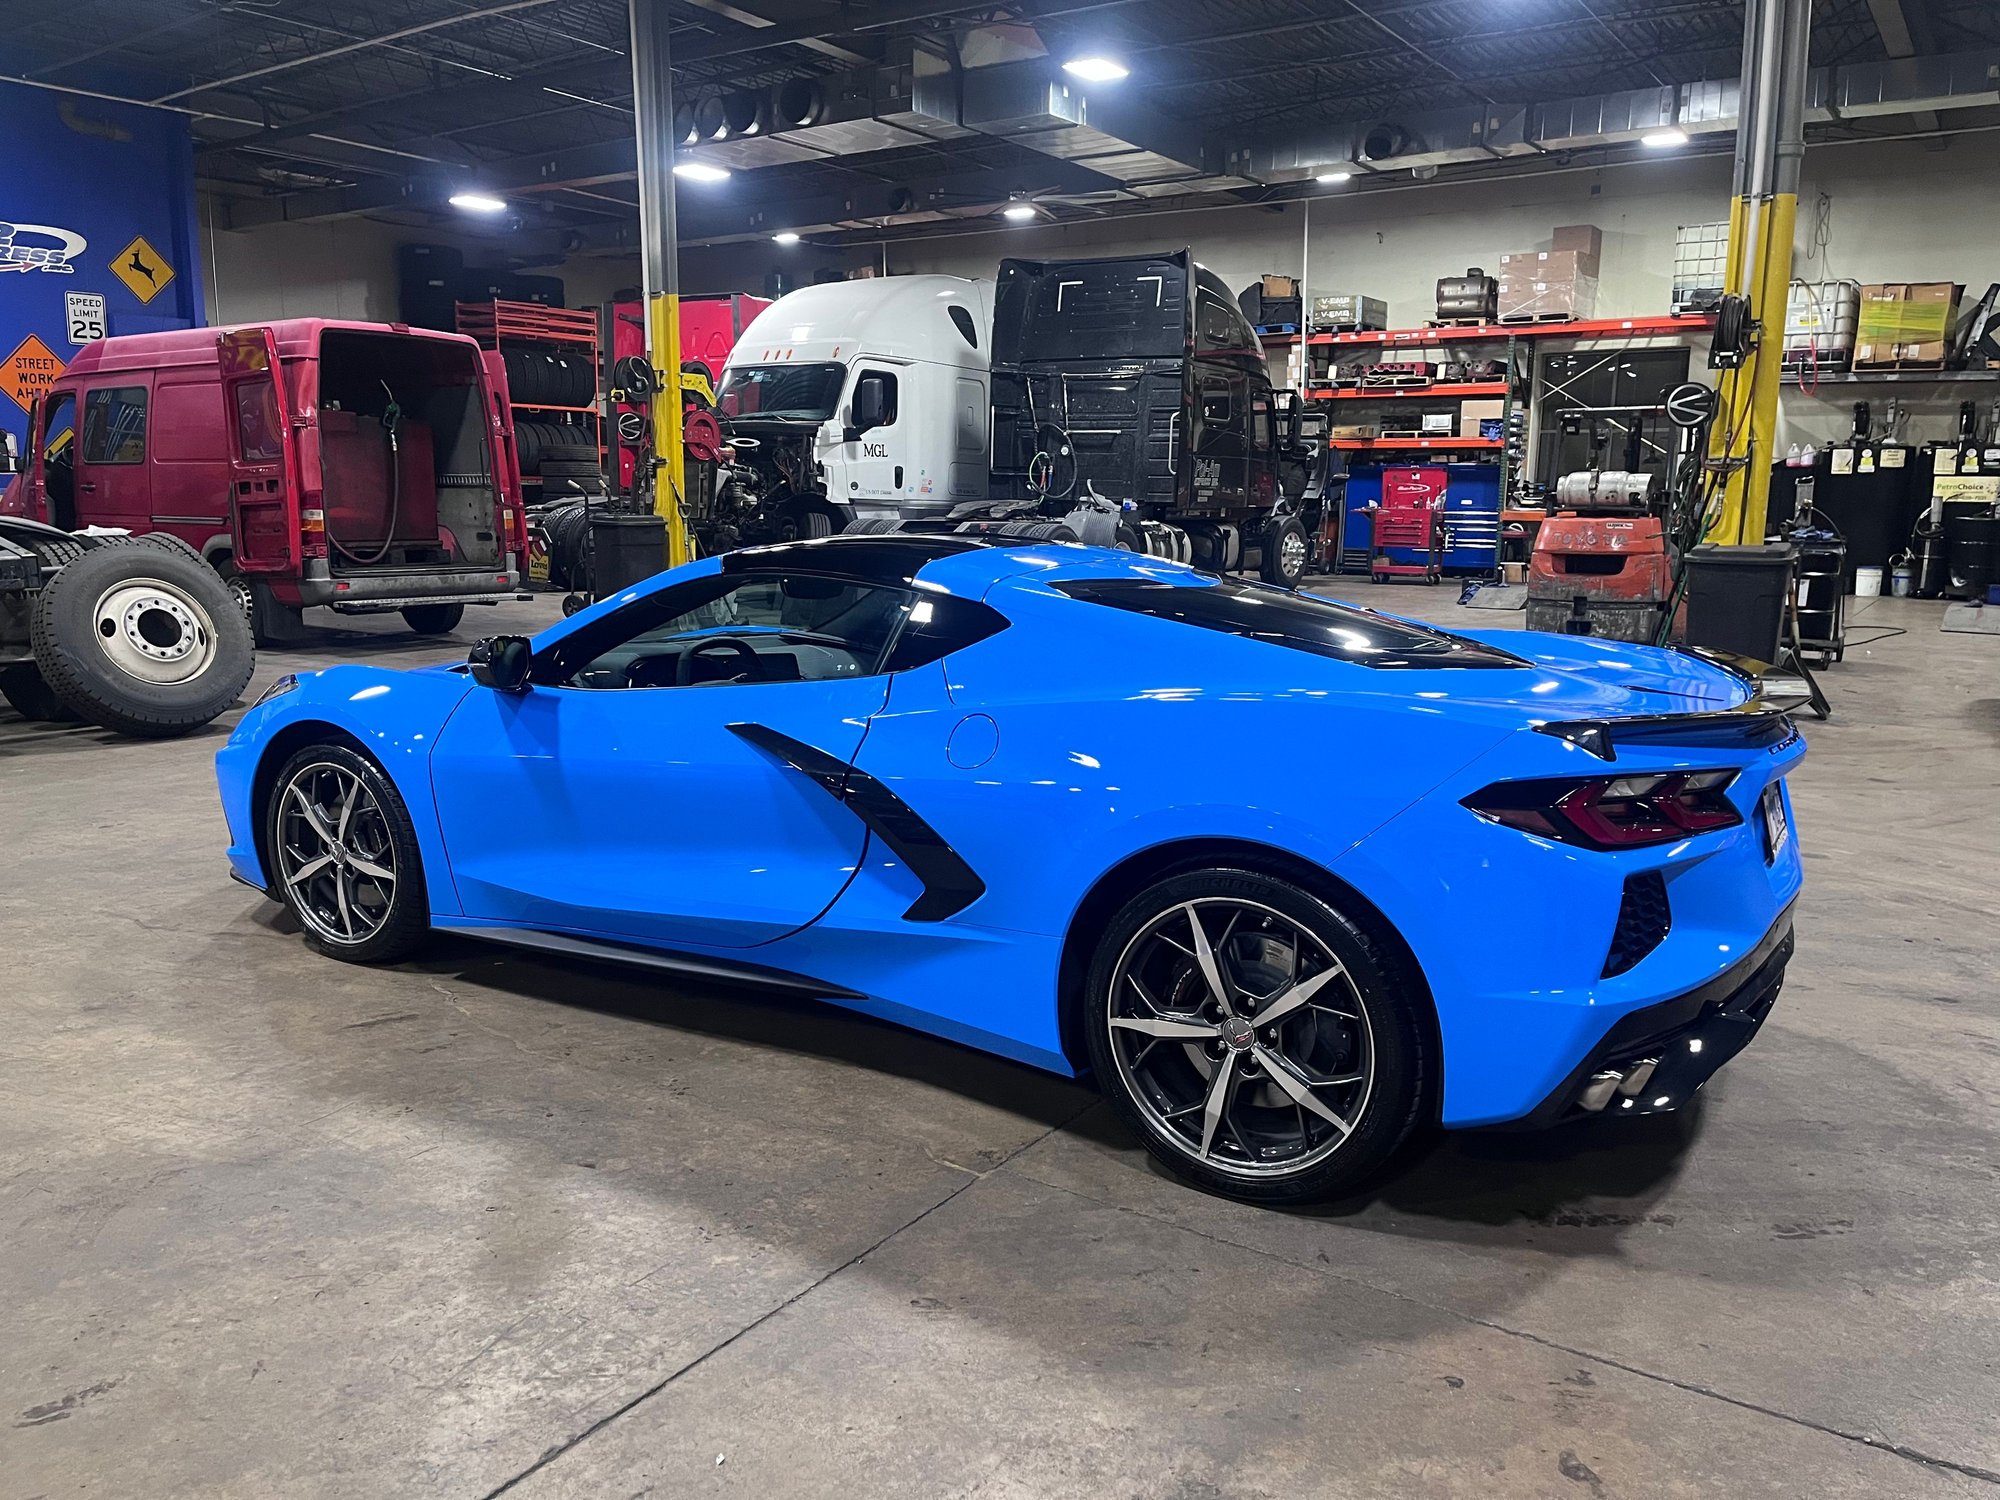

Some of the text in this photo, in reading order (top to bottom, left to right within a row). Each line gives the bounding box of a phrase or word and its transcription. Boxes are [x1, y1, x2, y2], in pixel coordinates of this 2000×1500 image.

[69, 298, 102, 307] SPEED
[73, 309, 98, 318] LIMIT
[72, 320, 103, 339] 25
[15, 357, 55, 370] STREET
[18, 372, 55, 384] WORK
[16, 387, 51, 398] AHA
[863, 443, 888, 457] MGL
